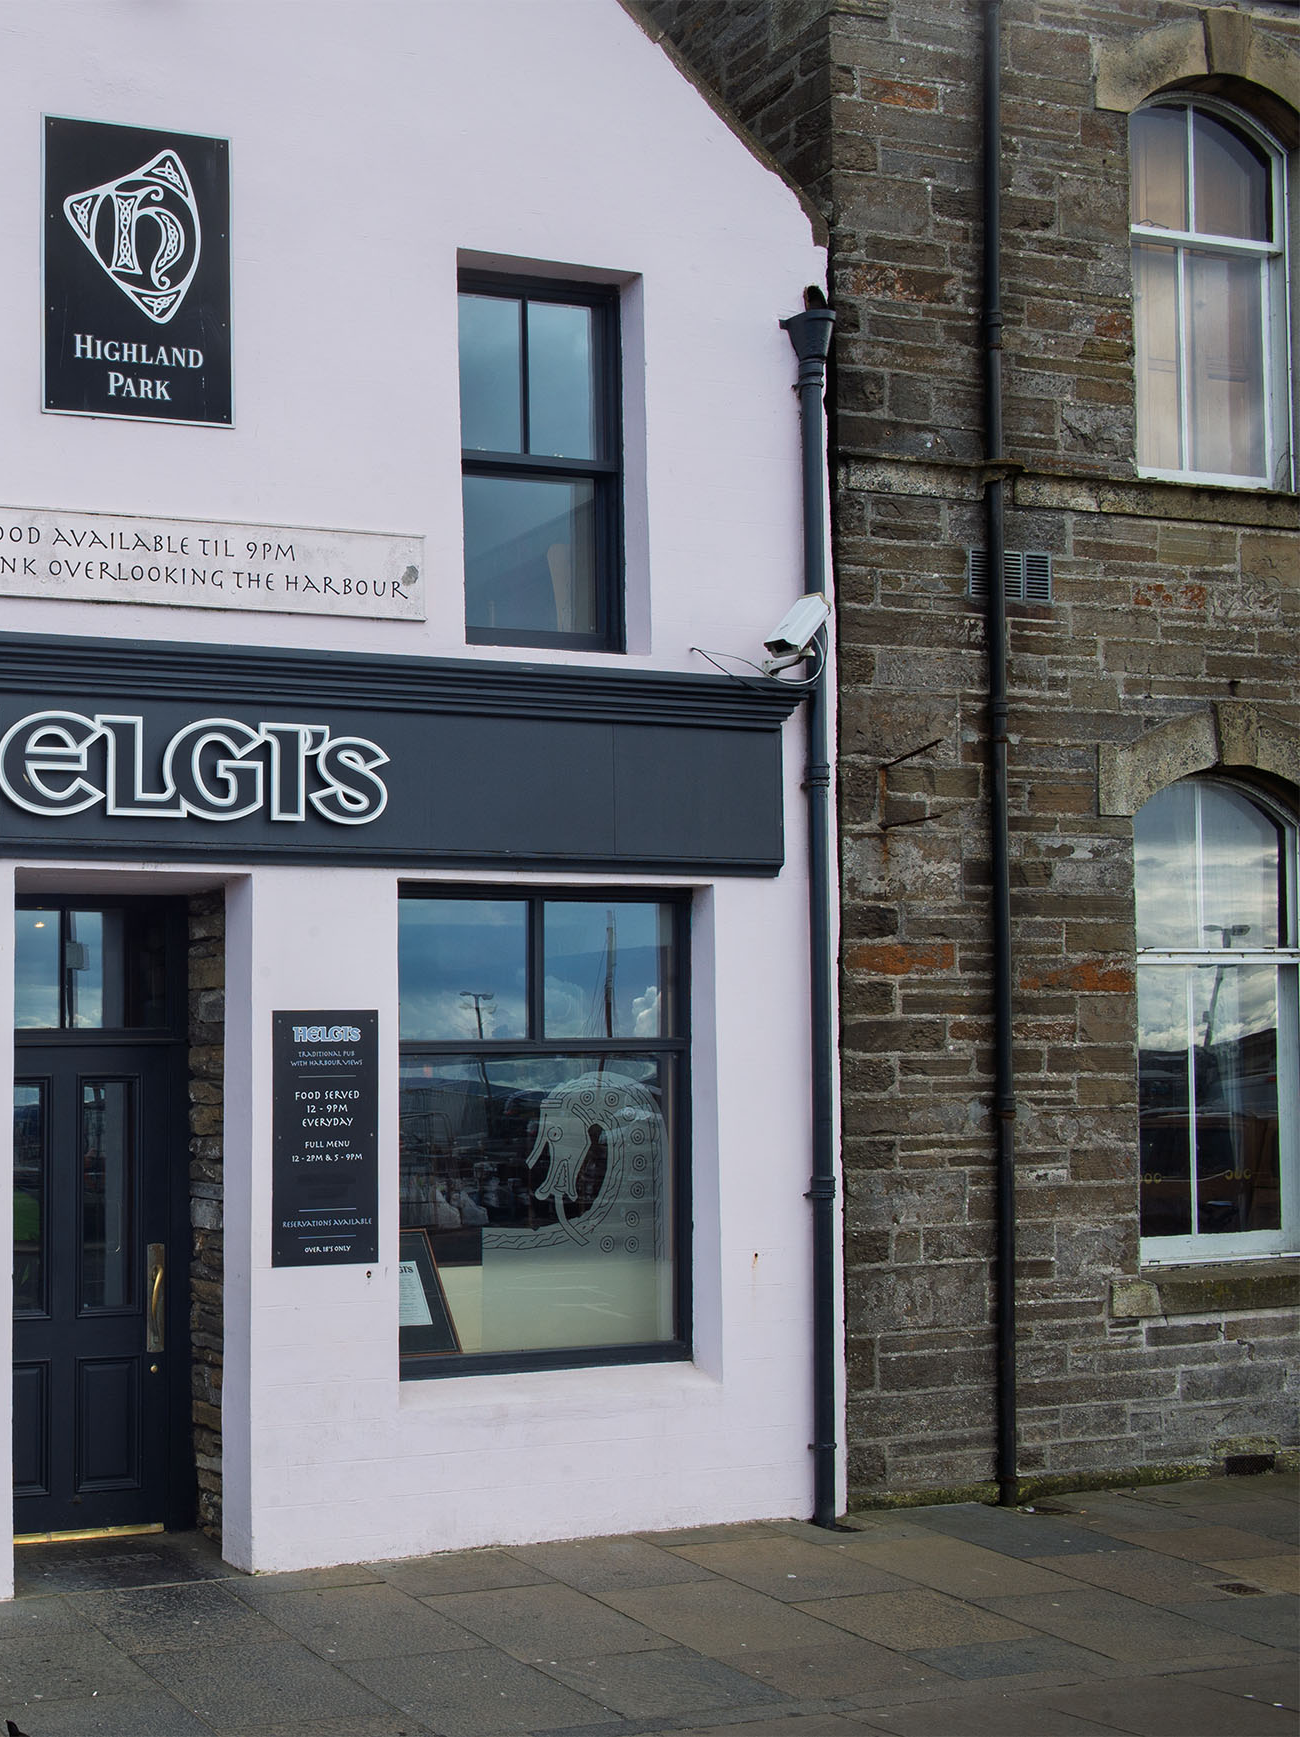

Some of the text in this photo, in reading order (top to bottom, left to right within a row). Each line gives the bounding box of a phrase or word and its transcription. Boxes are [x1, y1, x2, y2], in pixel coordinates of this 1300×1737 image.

[74, 334, 203, 368] HIGHLAND
[108, 372, 171, 401] PARK
[52, 528, 189, 555] AVAILABLE
[198, 538, 235, 559] TIL
[246, 542, 296, 562] 9PM
[48, 560, 224, 589] OVERLOOKING
[232, 571, 275, 591] THE
[284, 575, 408, 599] HARBOUR
[295, 1090, 360, 1101] FOOD SERVED
[307, 1105, 316, 1113] 12
[327, 1104, 348, 1113] 9PM
[302, 1117, 353, 1127] EVERYDAY
[305, 1140, 350, 1149] FULL MENU
[305, 1154, 323, 1162] 2PM
[346, 1153, 363, 1161] 9PM
[282, 1218, 372, 1228] RESERVATIONS AVAILABLE
